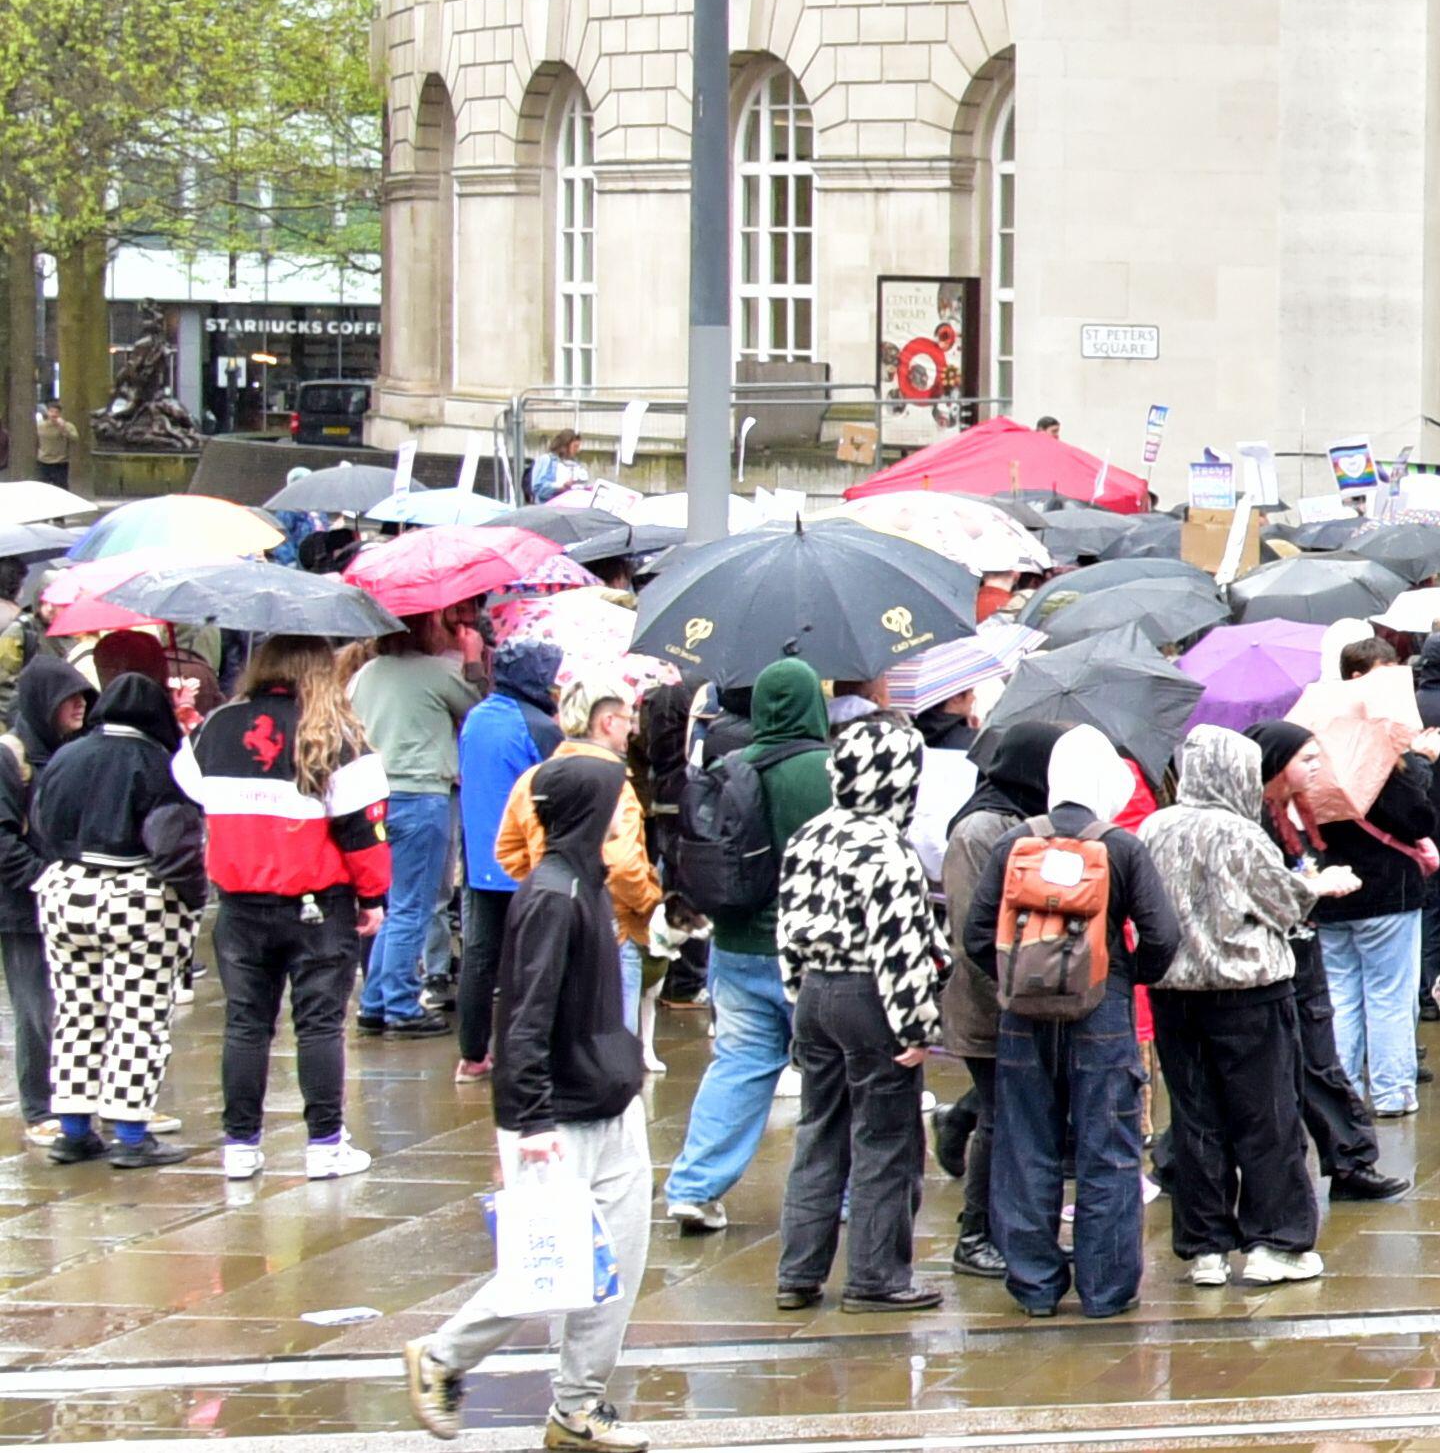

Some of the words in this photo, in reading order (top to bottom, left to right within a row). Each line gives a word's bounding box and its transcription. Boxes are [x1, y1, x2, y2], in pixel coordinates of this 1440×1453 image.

[327, 320, 382, 335] COFF
[1085, 329, 1100, 340] ST
[1093, 342, 1147, 356] SQUARE
